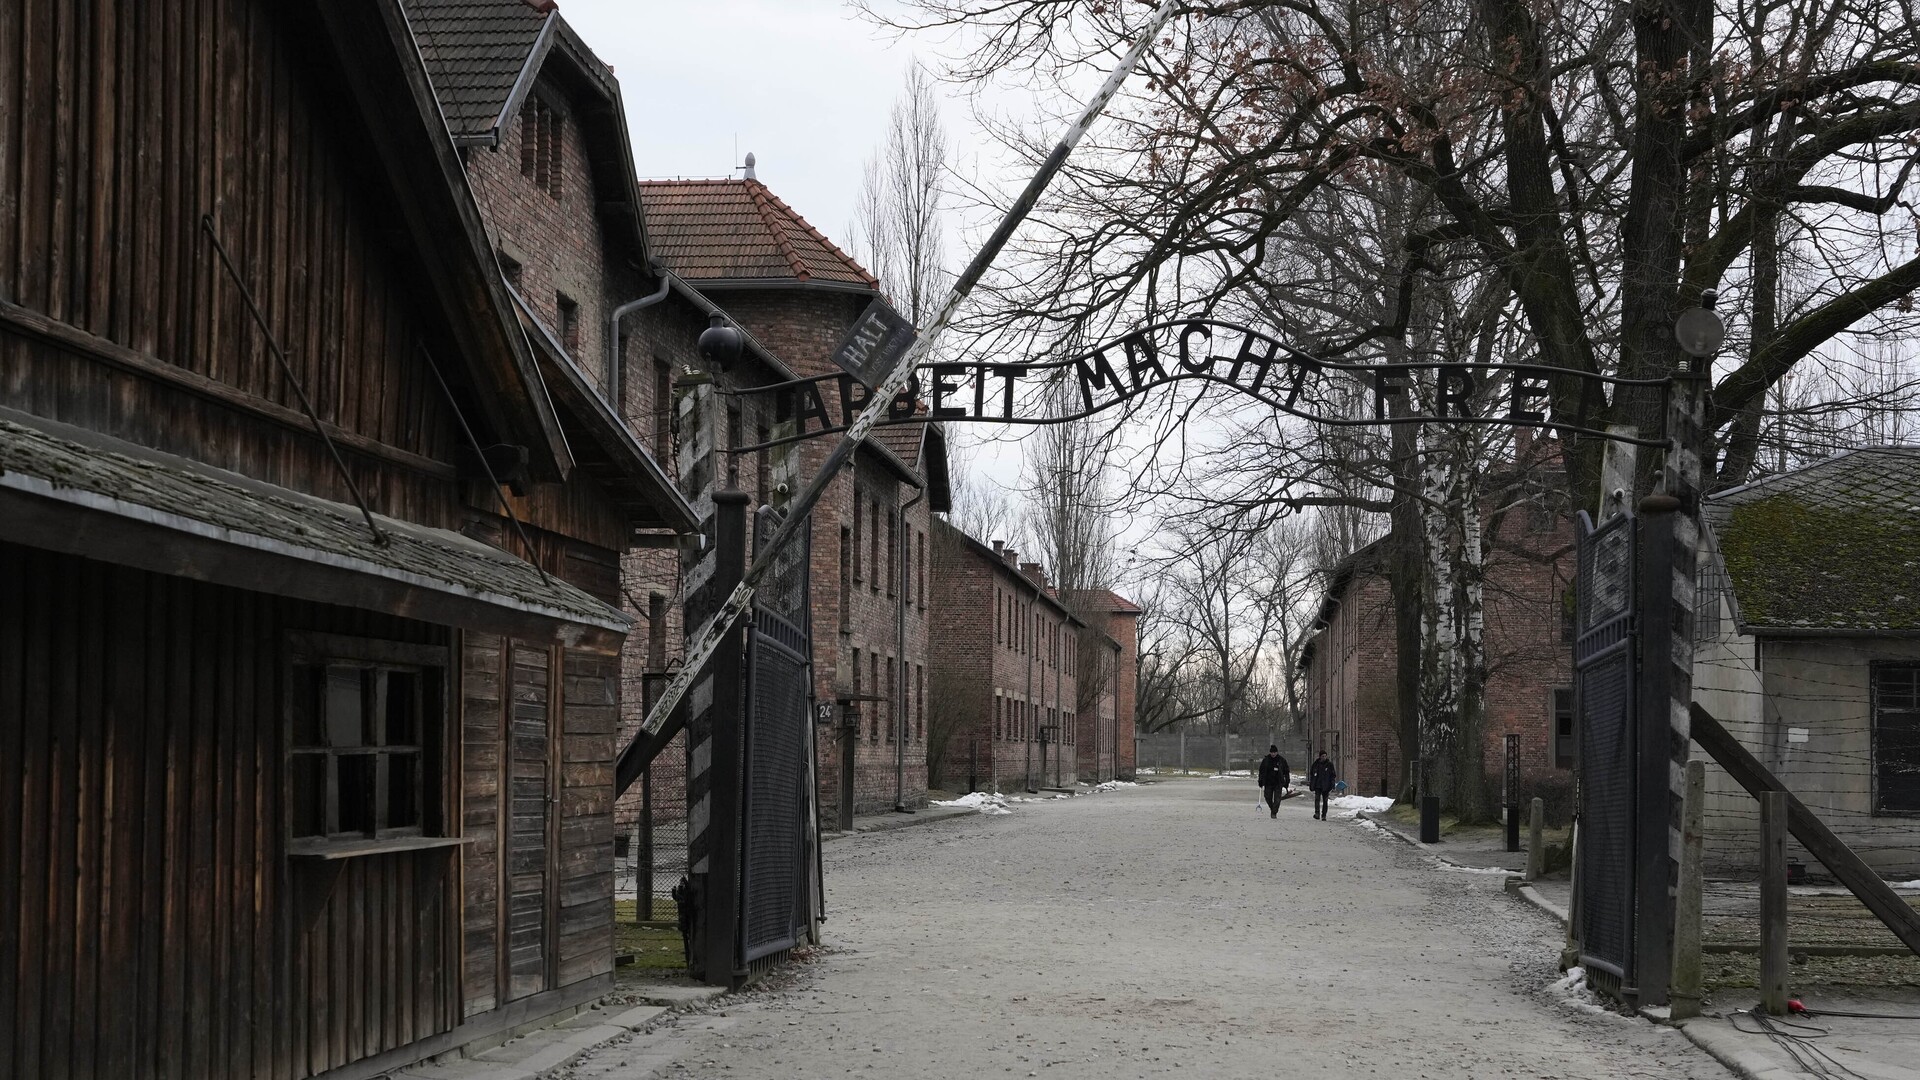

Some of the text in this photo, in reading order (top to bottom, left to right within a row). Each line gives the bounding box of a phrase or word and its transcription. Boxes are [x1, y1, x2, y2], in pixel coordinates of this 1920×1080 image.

[842, 312, 889, 367] HALT
[1076, 321, 1322, 412] MACHT
[819, 705, 831, 718] 24
